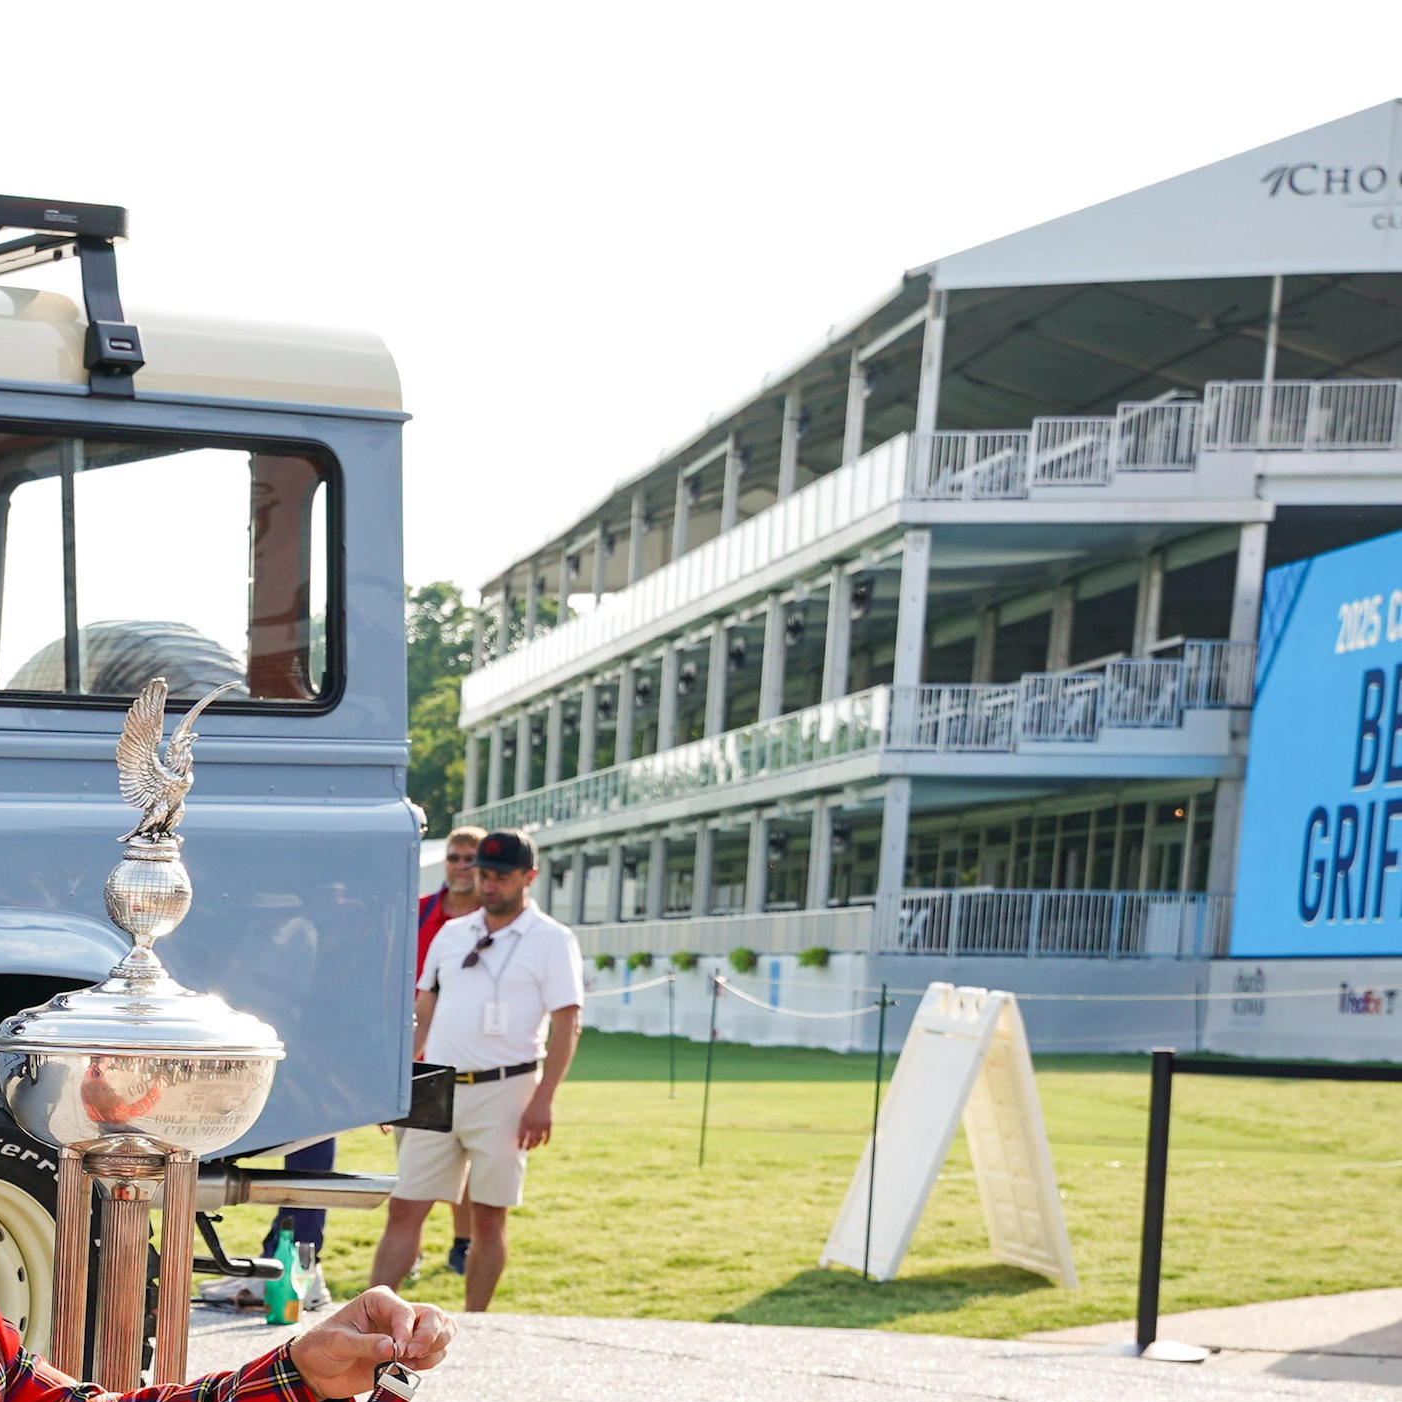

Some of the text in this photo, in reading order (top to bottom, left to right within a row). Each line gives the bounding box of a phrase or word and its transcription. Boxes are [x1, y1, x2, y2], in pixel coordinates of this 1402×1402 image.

[1287, 161, 1402, 196] CHO
[1371, 213, 1402, 230] CL
[1335, 594, 1383, 655] 2025
